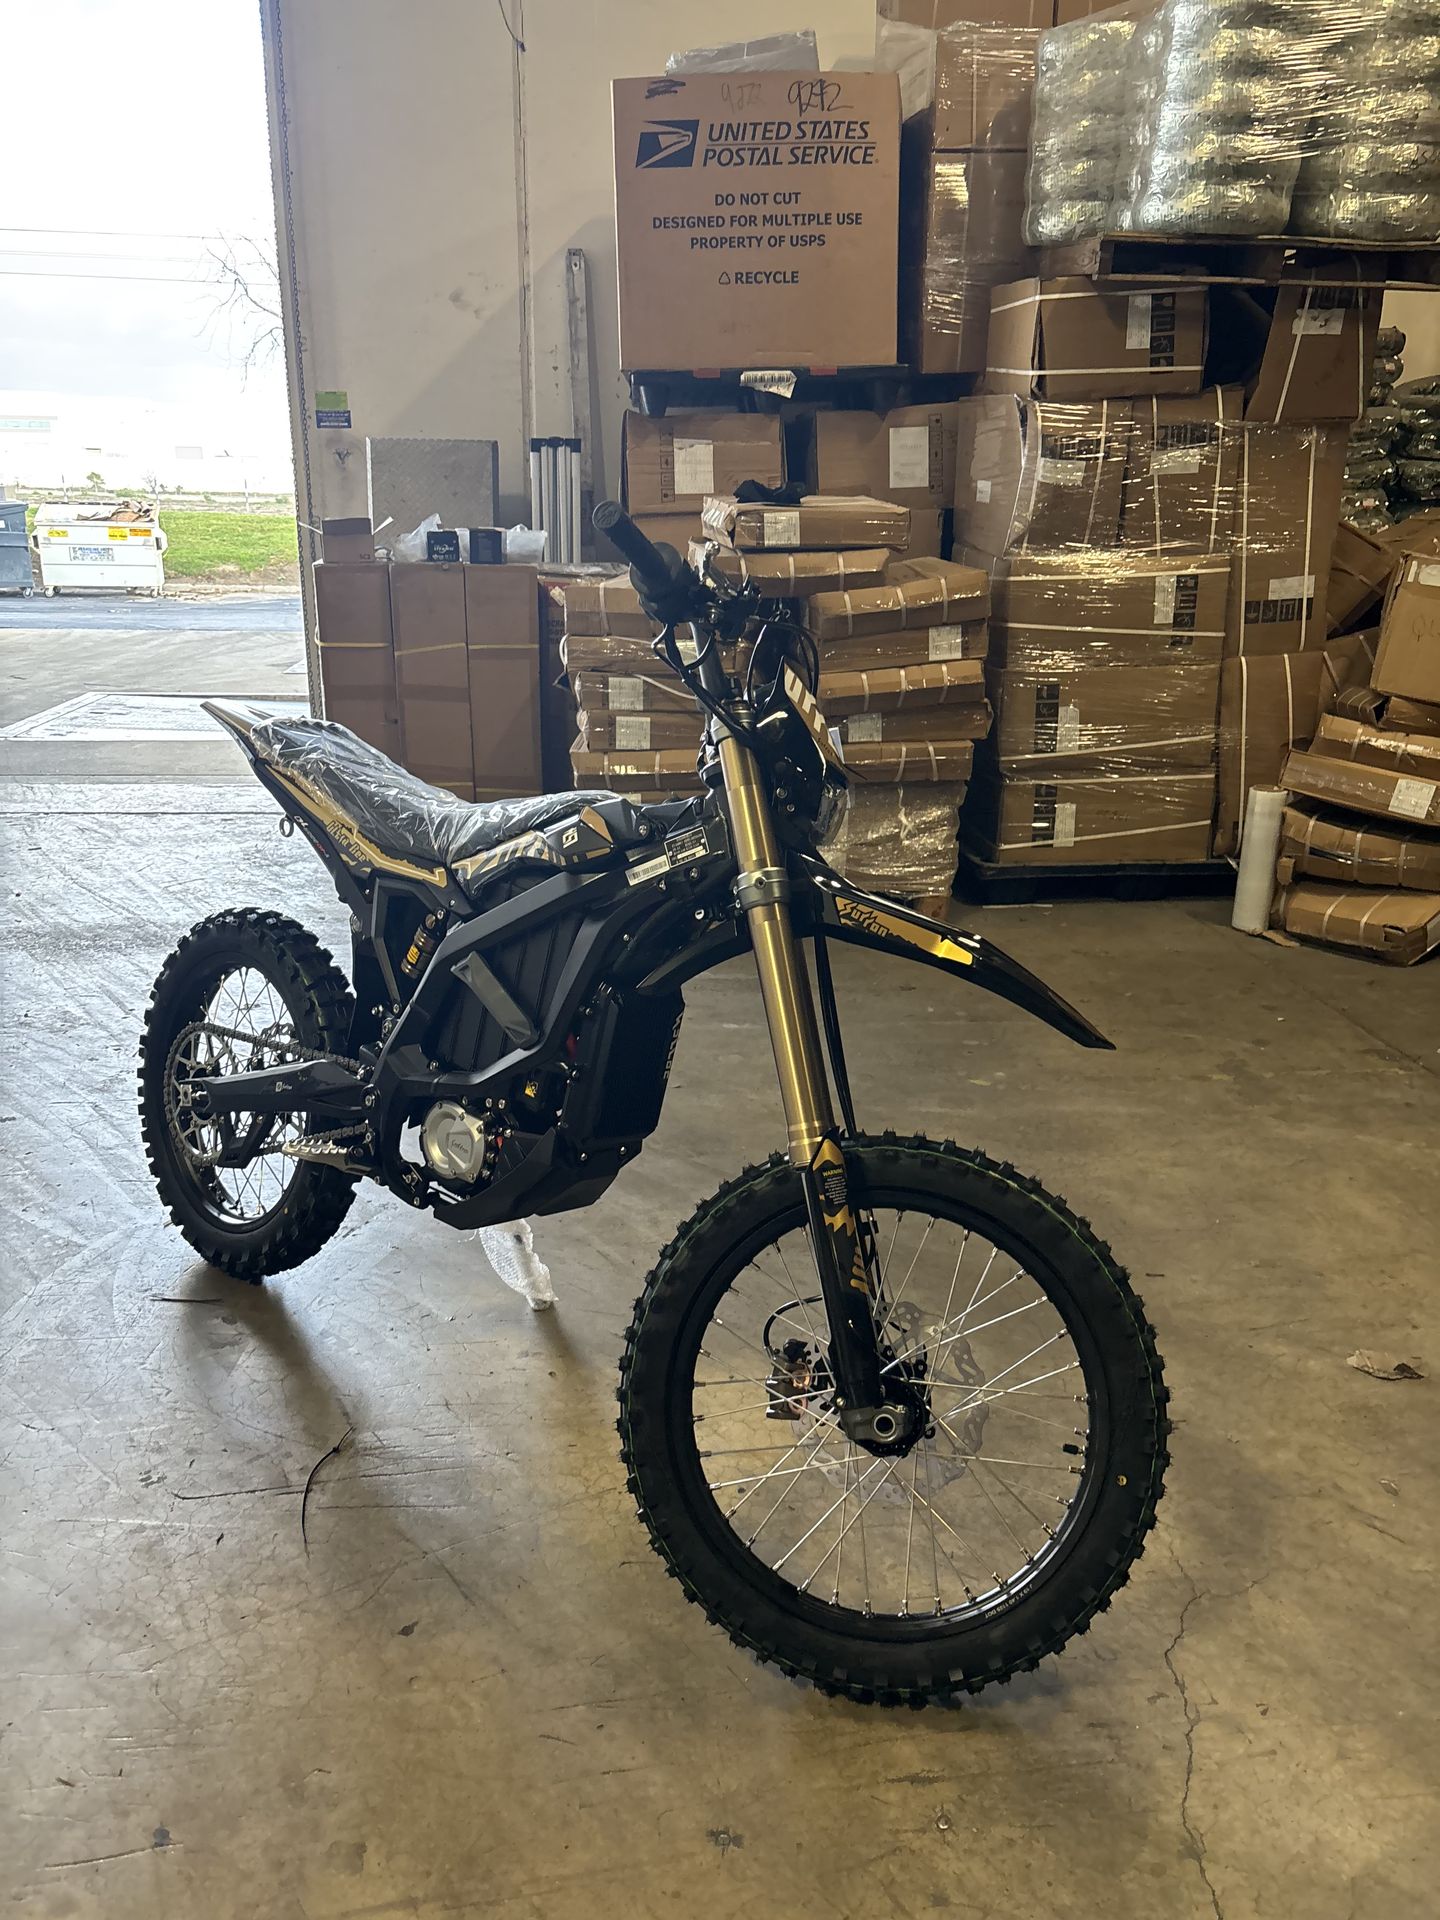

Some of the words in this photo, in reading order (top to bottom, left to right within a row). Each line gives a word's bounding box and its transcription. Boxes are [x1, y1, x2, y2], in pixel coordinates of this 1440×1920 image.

[708, 121, 792, 142] UNITED
[795, 120, 870, 140] STATES
[703, 146, 783, 167] POSTAL
[788, 145, 876, 165] SERVICE
[714, 193, 736, 206] DO
[740, 192, 769, 205] NOT
[773, 191, 801, 205] CUT
[652, 215, 725, 229] DESIGNED
[730, 214, 758, 228] FOR
[762, 212, 832, 227] MULTIPLE
[836, 212, 863, 226] USE
[690, 235, 764, 249] PROPERTY
[767, 235, 786, 248] OF
[790, 234, 827, 248] USPS
[734, 271, 800, 285] RECYCLE
[985, 1610, 996, 1618] DOT
